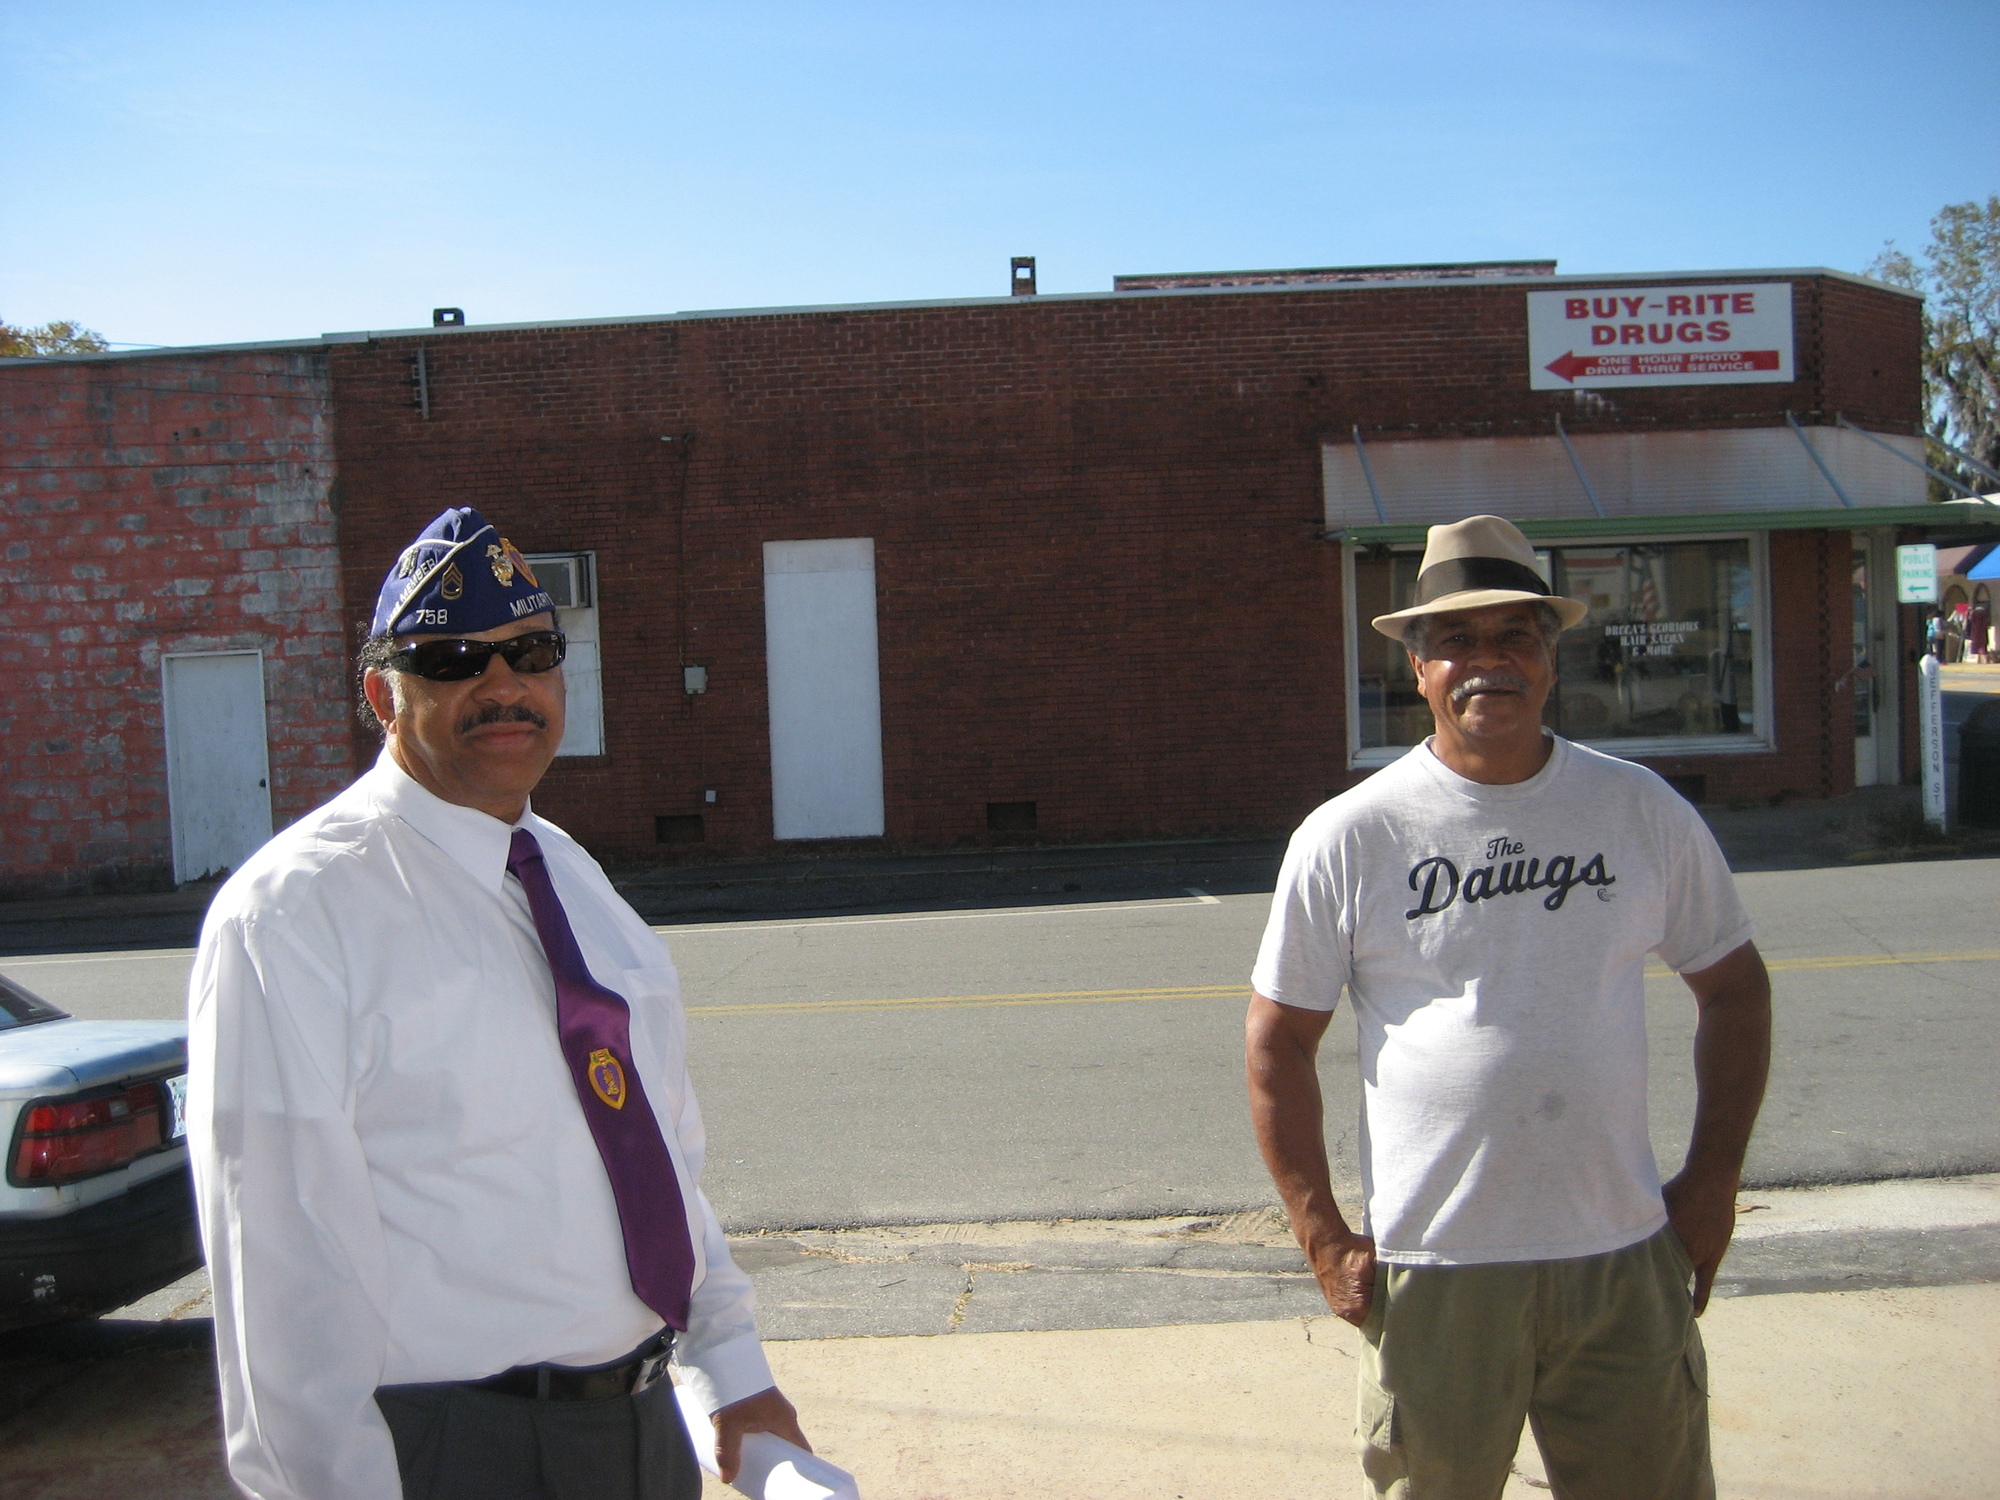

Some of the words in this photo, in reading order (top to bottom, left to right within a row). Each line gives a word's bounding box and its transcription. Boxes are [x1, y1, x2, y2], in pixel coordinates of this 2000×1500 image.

[1565, 293, 1755, 319] BUY-RITE
[1591, 321, 1731, 345] DRUGS
[1585, 365, 1631, 376] DRIVE
[1638, 363, 1680, 374] THRU
[1687, 361, 1754, 373] SERVICE
[1598, 356, 1631, 365] ONE
[1638, 353, 1683, 364] HOUR
[1689, 351, 1742, 363] PHOTO
[1903, 554, 1931, 564] PUBLIC
[400, 558, 436, 602] MEMBER
[1901, 568, 1933, 579] PARKING
[416, 608, 448, 625] 758
[1930, 665, 1940, 774] JEFFERSON
[1933, 782, 1941, 805] ST
[1486, 836, 1525, 860] The
[1405, 852, 1616, 920] Dawgs
